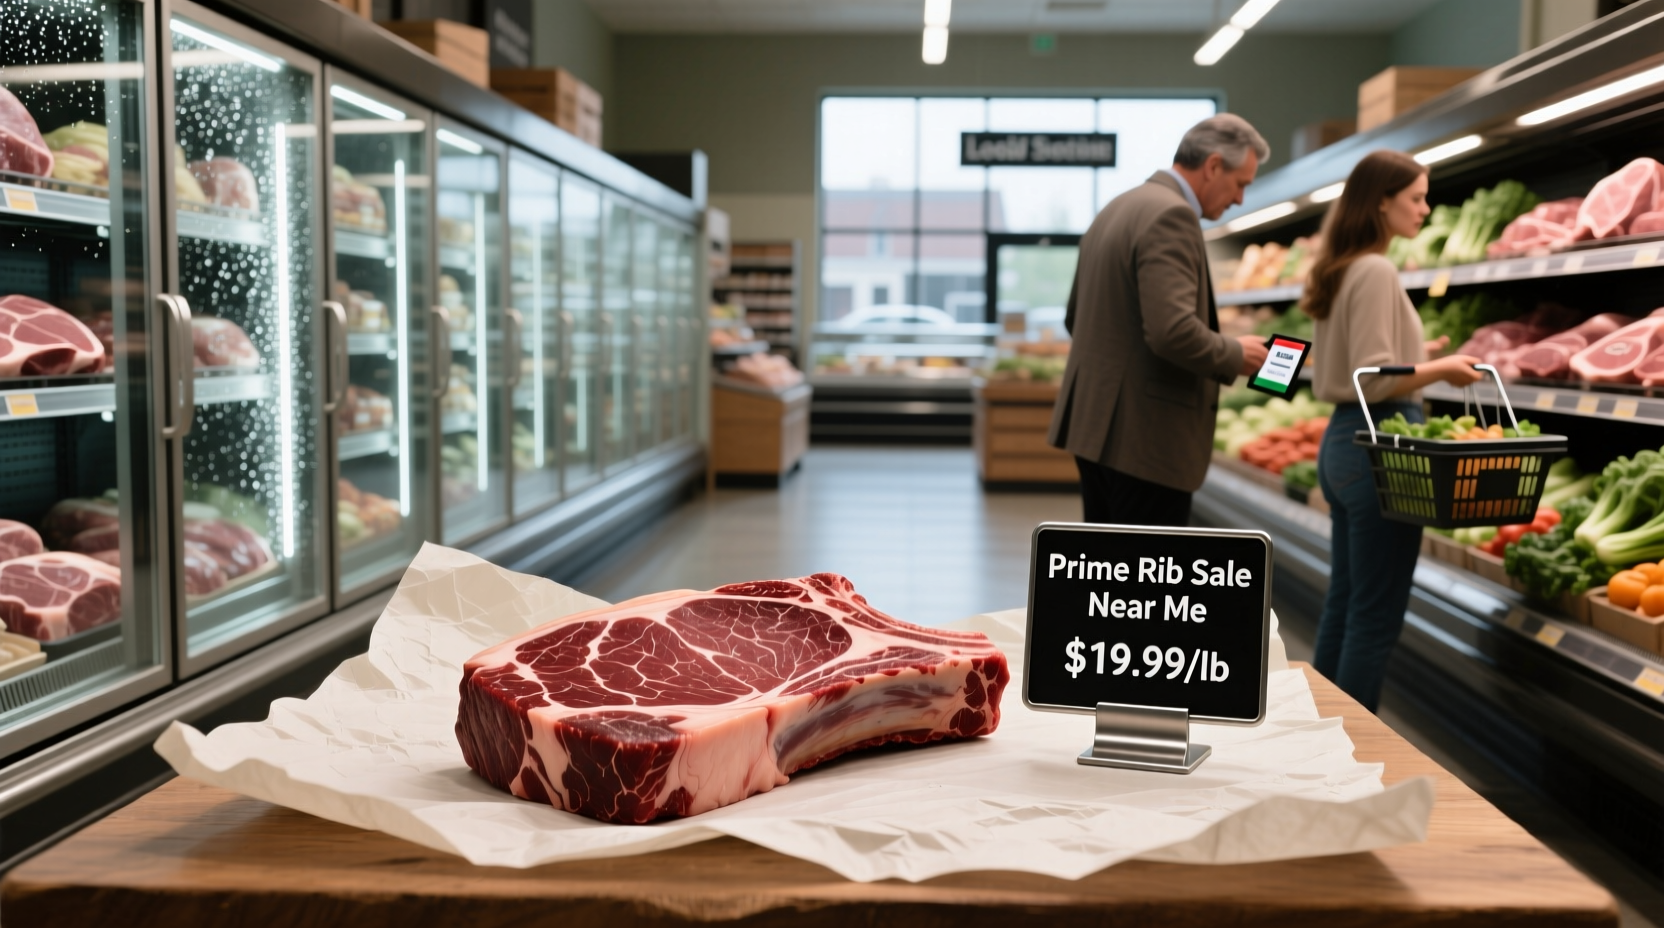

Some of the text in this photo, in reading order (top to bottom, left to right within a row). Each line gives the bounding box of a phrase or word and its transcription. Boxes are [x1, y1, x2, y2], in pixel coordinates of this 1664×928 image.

[1048, 553, 1252, 588] Prime Rib Sale
[1088, 591, 1207, 624] Near Me
[1064, 635, 1230, 684] $19.99/lb
